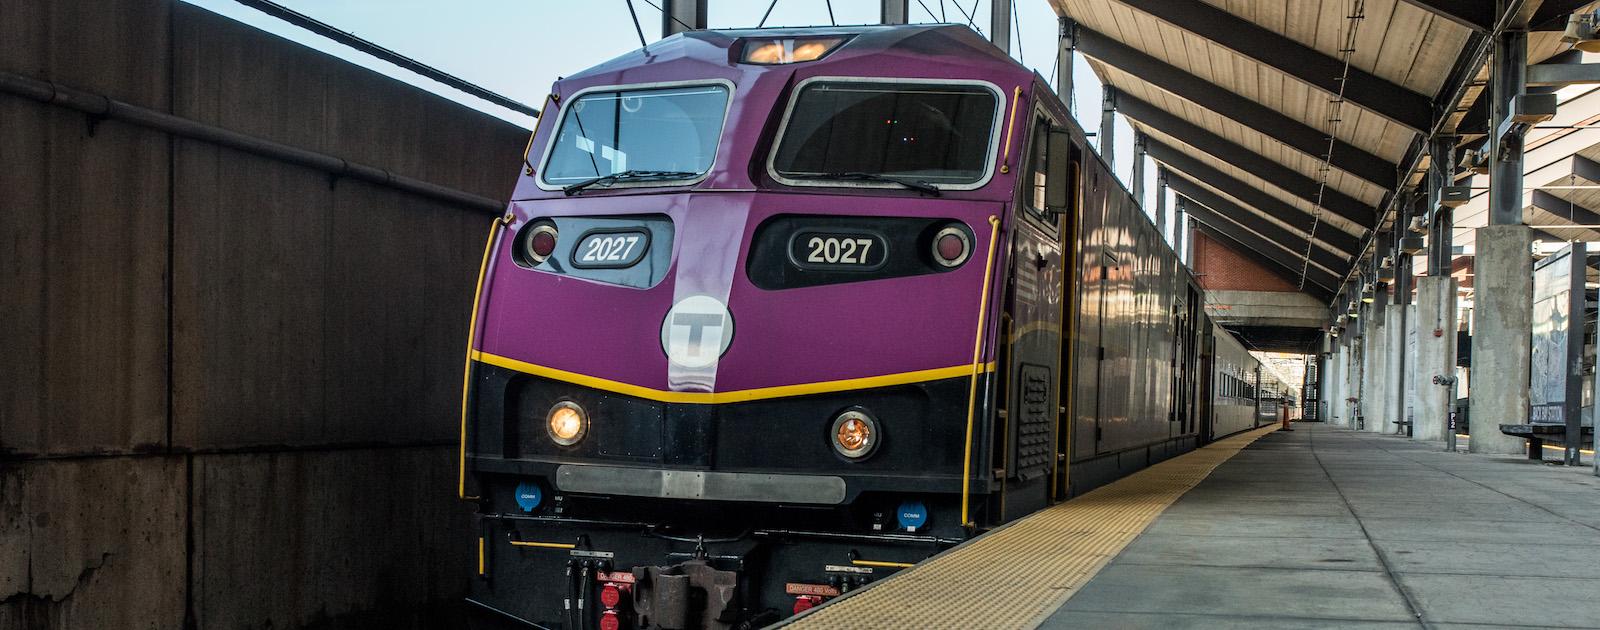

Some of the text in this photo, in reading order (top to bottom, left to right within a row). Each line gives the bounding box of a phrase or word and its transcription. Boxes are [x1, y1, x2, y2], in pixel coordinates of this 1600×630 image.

[583, 236, 639, 261] 2027
[808, 237, 873, 264] 2027
[672, 312, 724, 357] T
[789, 584, 812, 593] DANGER
